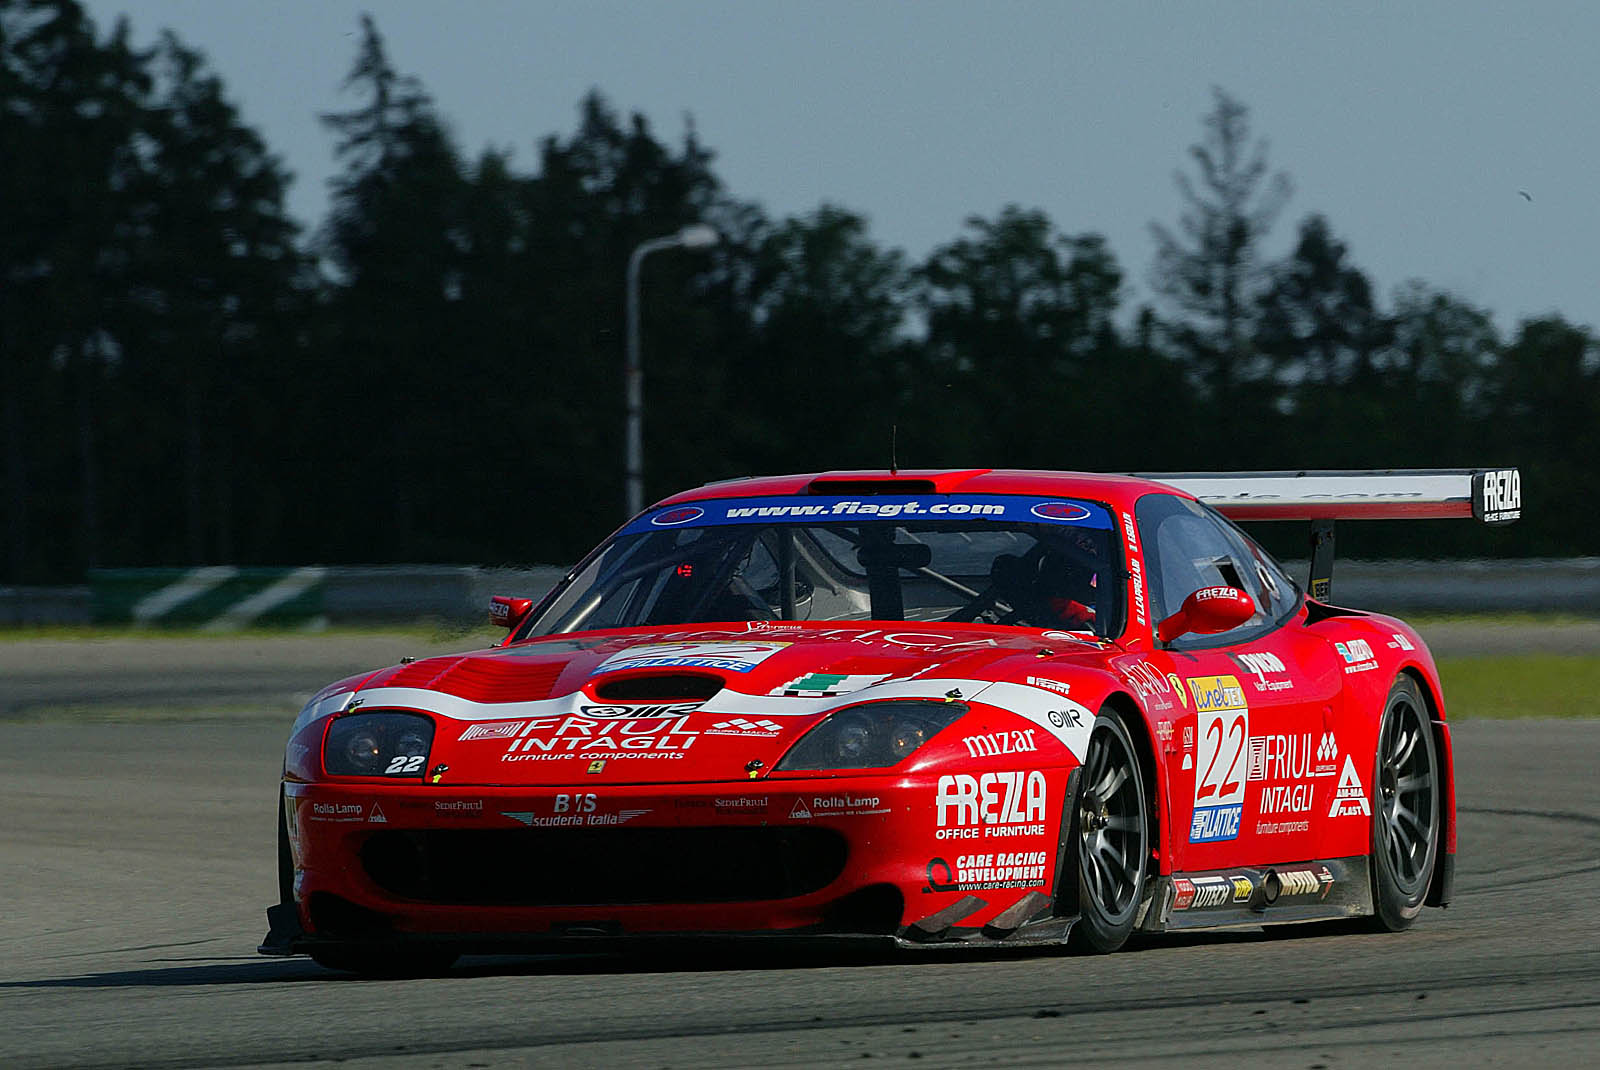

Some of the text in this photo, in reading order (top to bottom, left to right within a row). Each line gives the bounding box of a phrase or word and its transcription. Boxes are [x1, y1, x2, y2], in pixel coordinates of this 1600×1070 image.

[727, 502, 1005, 518] www.fiagt.com
[519, 715, 700, 737] FRIUL
[508, 736, 696, 752] INTAGLI
[962, 728, 1038, 758] mizar
[501, 752, 685, 762] furniture components
[1197, 715, 1246, 800] 22
[1264, 733, 1314, 780] FRIUL
[384, 756, 426, 774] 22
[813, 797, 880, 808] Rolla Lamp
[1260, 784, 1314, 814] INTAGLI
[313, 803, 362, 814] Rolla Lamp
[1338, 806, 1361, 816] PLAST
[533, 814, 617, 827] scuderia italia
[936, 825, 1045, 839] OFFICE FURNITURE
[956, 852, 1046, 868] CARE RACING
[958, 866, 1046, 883] DEVELOPMENT
[958, 879, 1044, 891] www.care-racing.com
